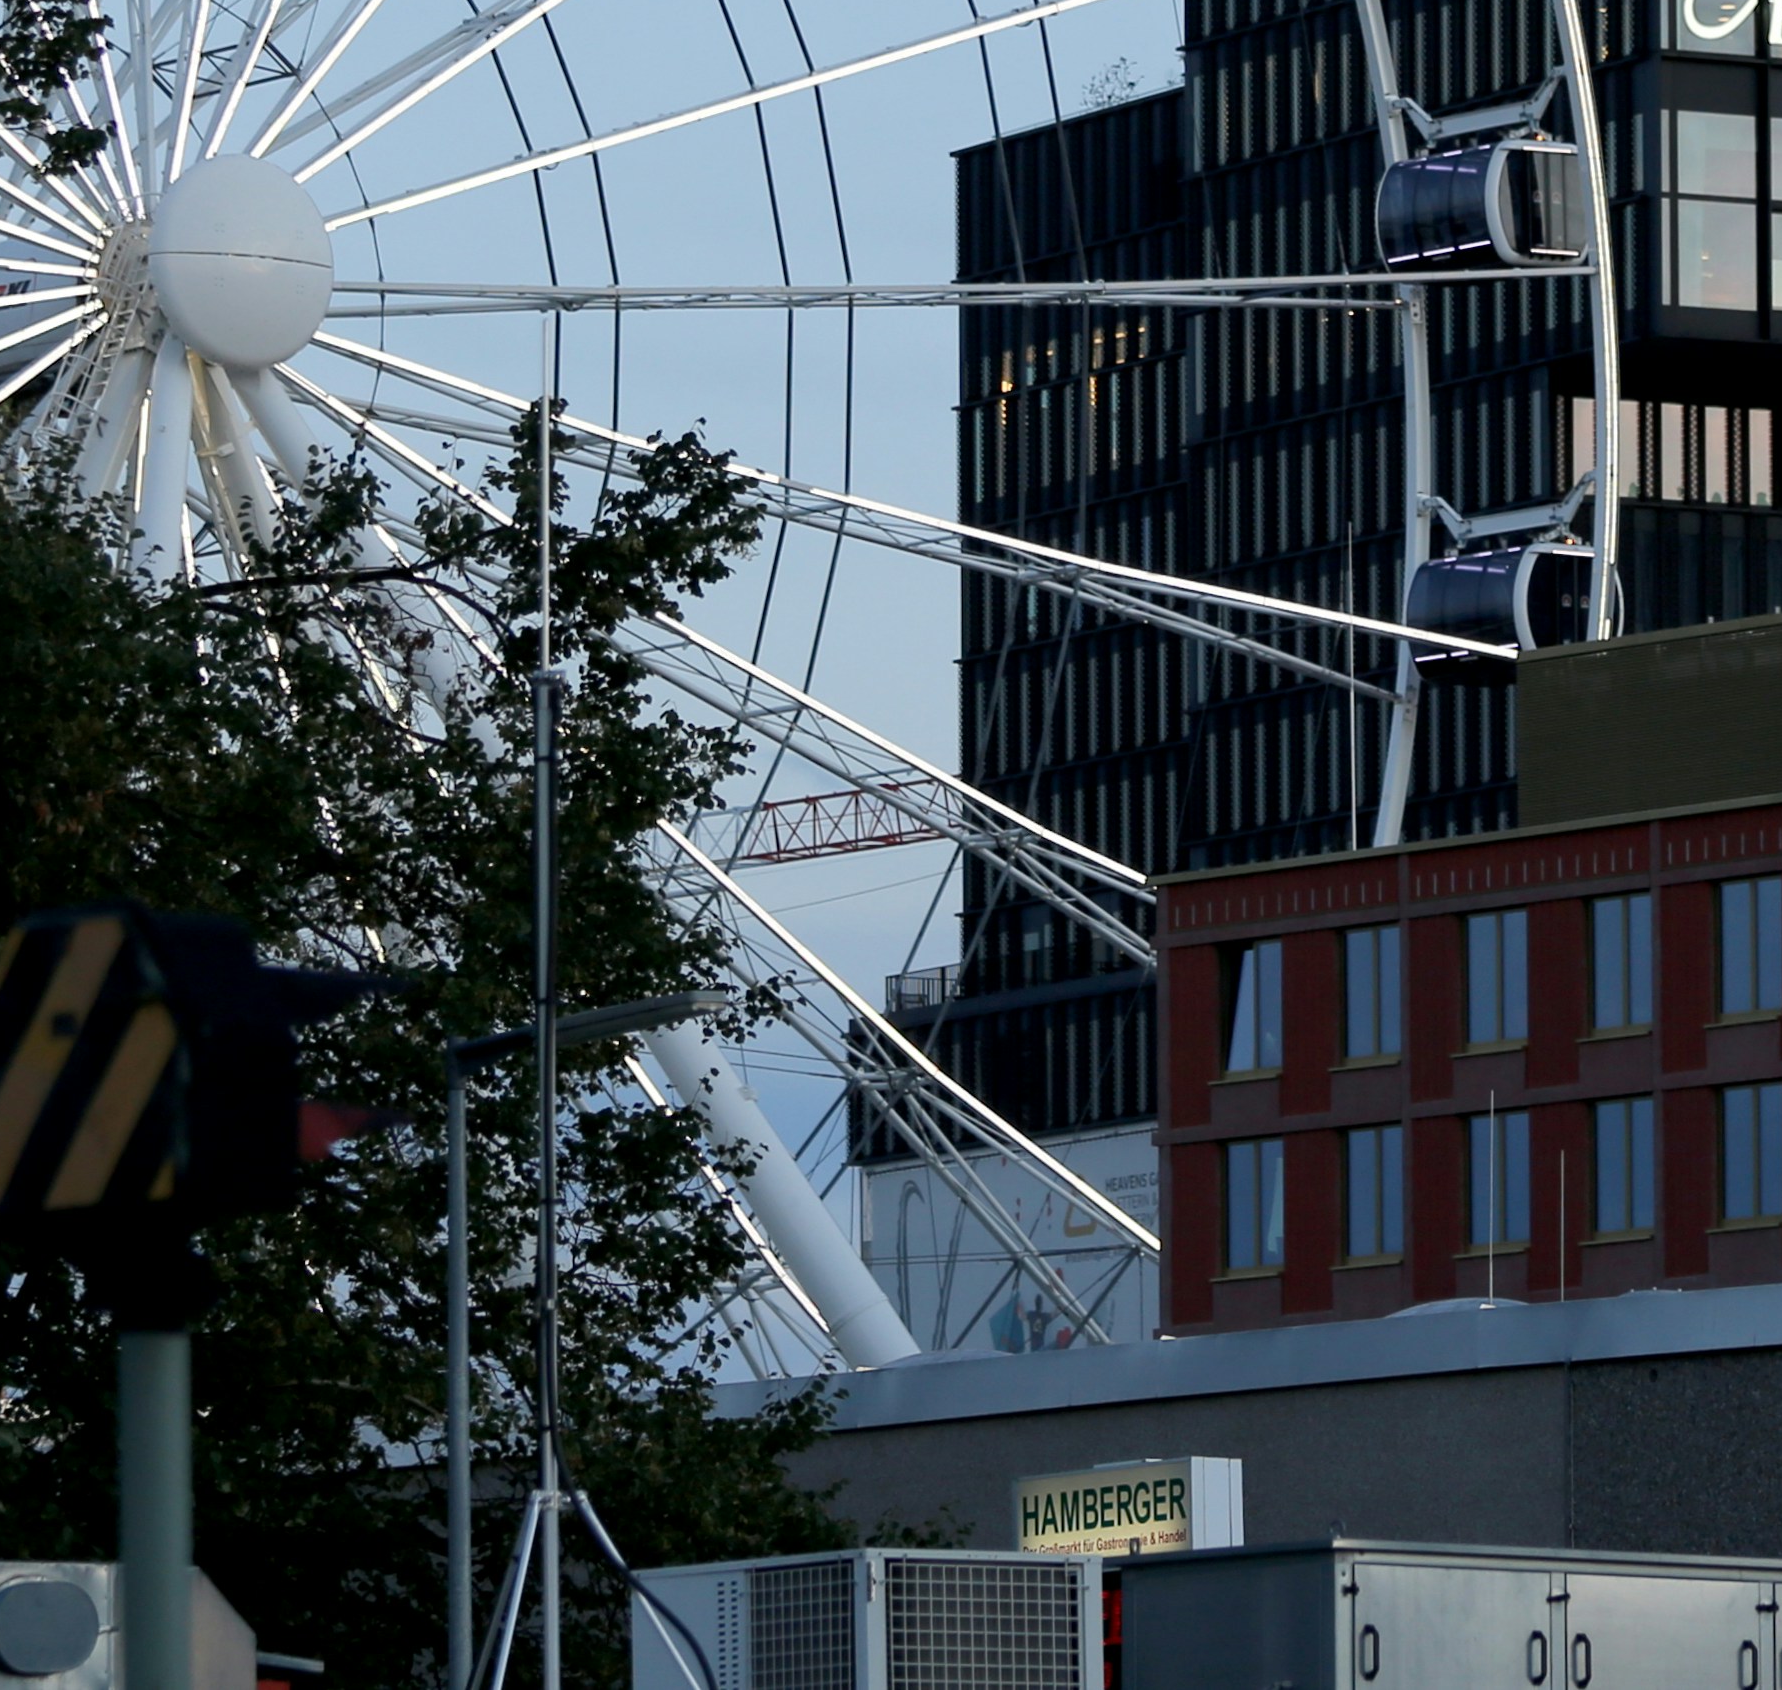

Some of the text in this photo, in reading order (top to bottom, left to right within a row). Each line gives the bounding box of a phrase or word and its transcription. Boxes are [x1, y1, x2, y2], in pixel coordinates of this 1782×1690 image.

[1022, 1478, 1186, 1537] HAMBERGER
[1150, 1532, 1156, 1545] &
[1158, 1528, 1187, 1544] Handel
